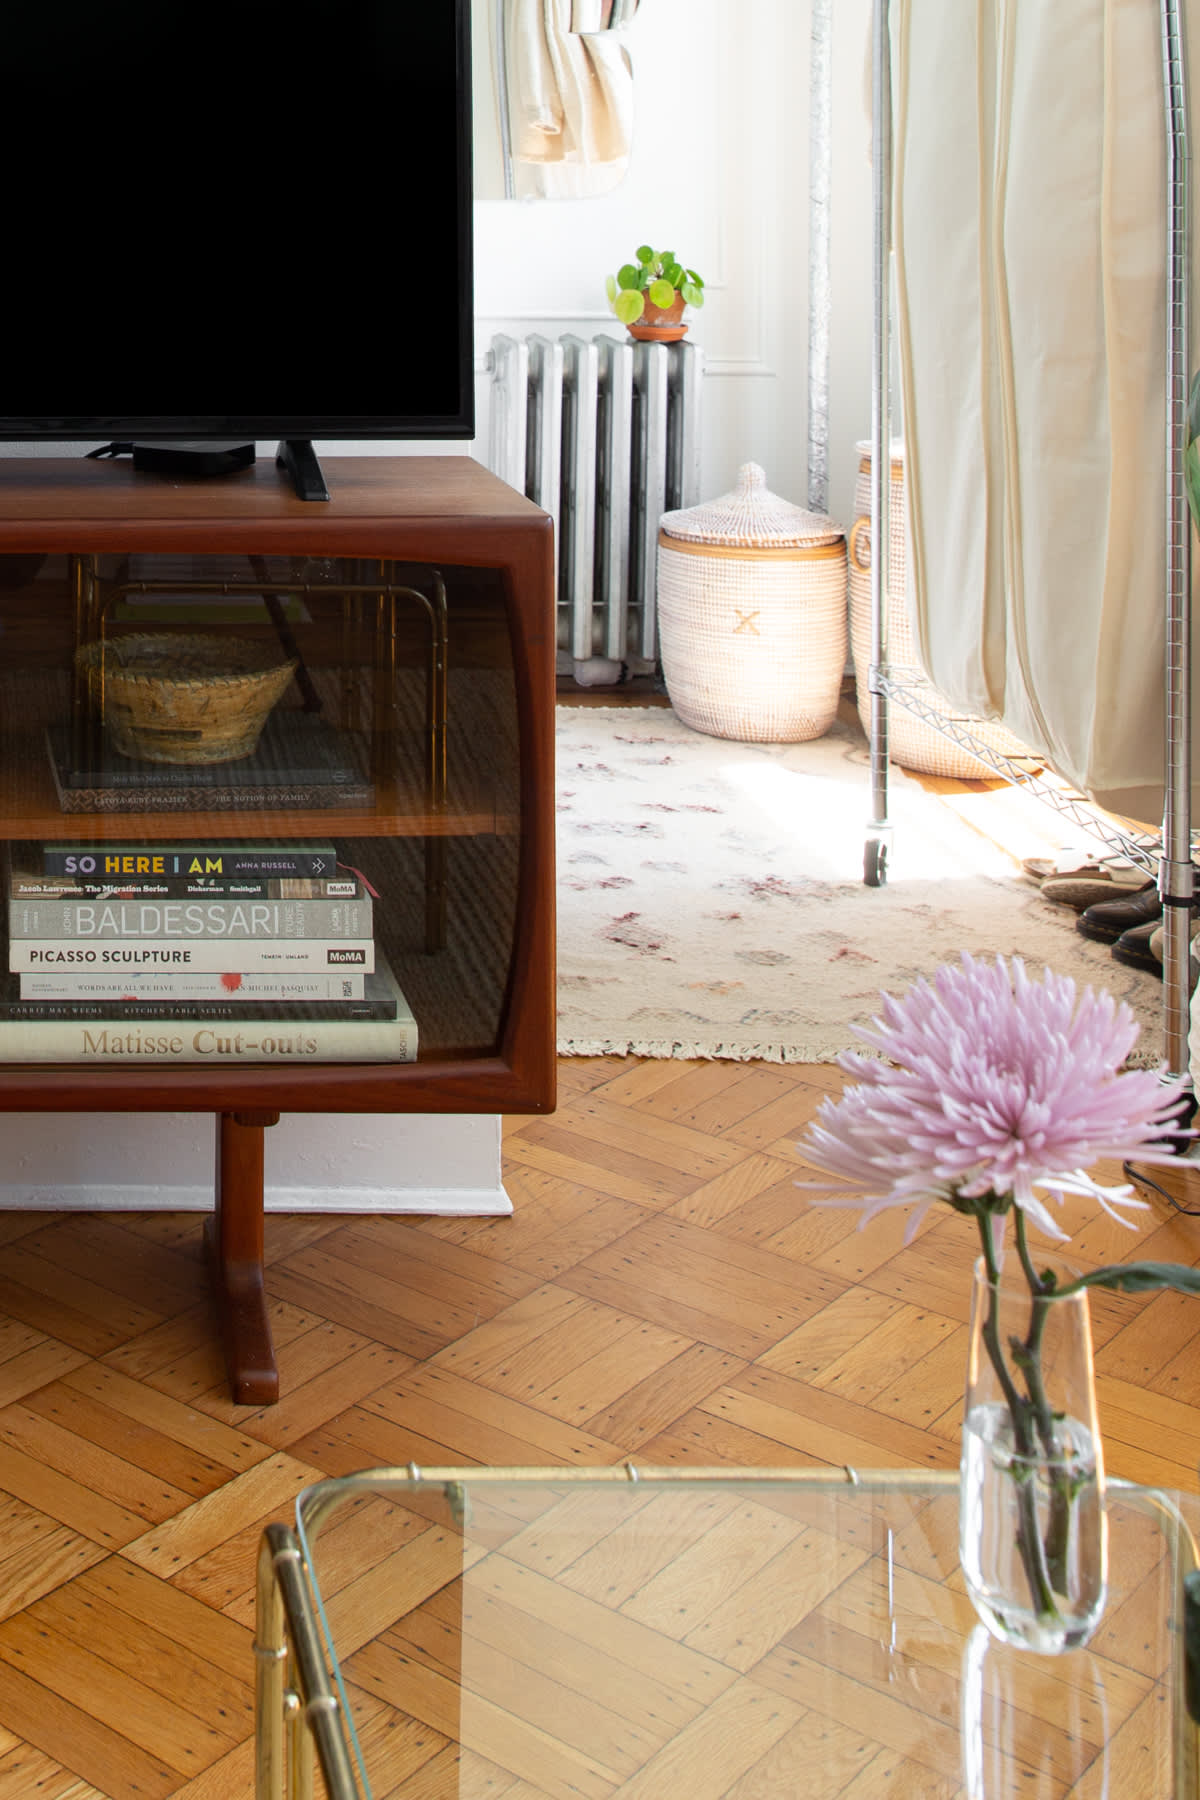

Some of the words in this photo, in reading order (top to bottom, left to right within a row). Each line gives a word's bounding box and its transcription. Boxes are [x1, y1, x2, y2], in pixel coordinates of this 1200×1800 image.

[65, 856, 96, 873] SO
[105, 856, 165, 873] HERE
[174, 856, 179, 873] I
[188, 857, 223, 874] AM
[18, 885, 42, 893] Jacob
[85, 885, 101, 893] The
[102, 885, 142, 893] Migration
[143, 885, 168, 893] Series
[329, 885, 353, 893] MoMA
[64, 907, 72, 935] JOHN
[76, 905, 280, 935] BALDESSARI
[30, 951, 96, 962] PICASSO
[102, 951, 192, 962] SCULPTURE
[330, 951, 363, 962] MoMA
[82, 1028, 183, 1054] Matisse
[192, 1030, 318, 1054] Cut-outs
